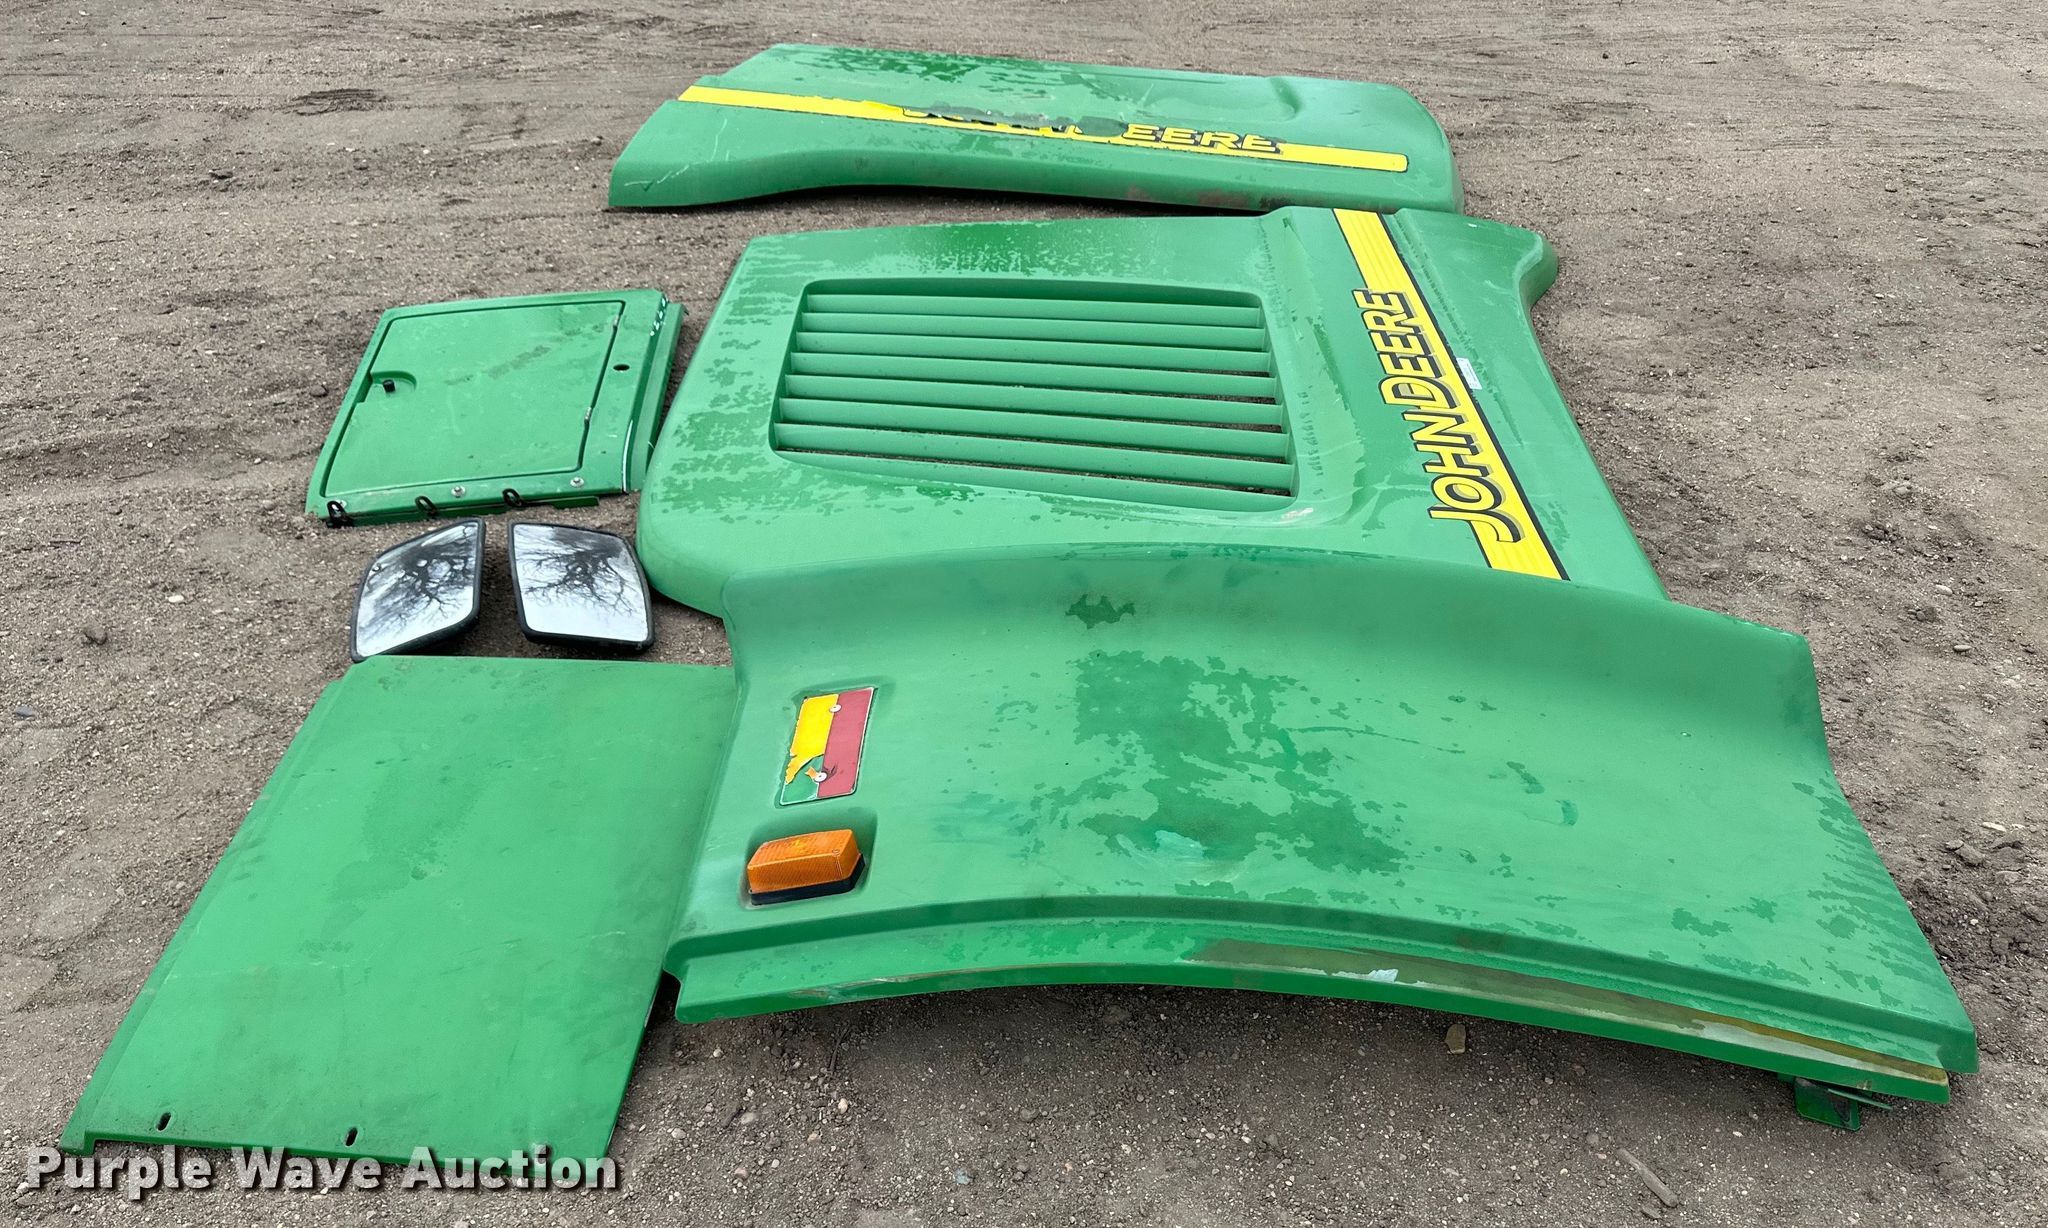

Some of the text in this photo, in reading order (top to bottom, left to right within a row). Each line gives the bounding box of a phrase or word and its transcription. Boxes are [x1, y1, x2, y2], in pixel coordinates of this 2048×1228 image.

[1076, 115, 1284, 155] EERE
[1352, 288, 1525, 543] JOHN DEERE
